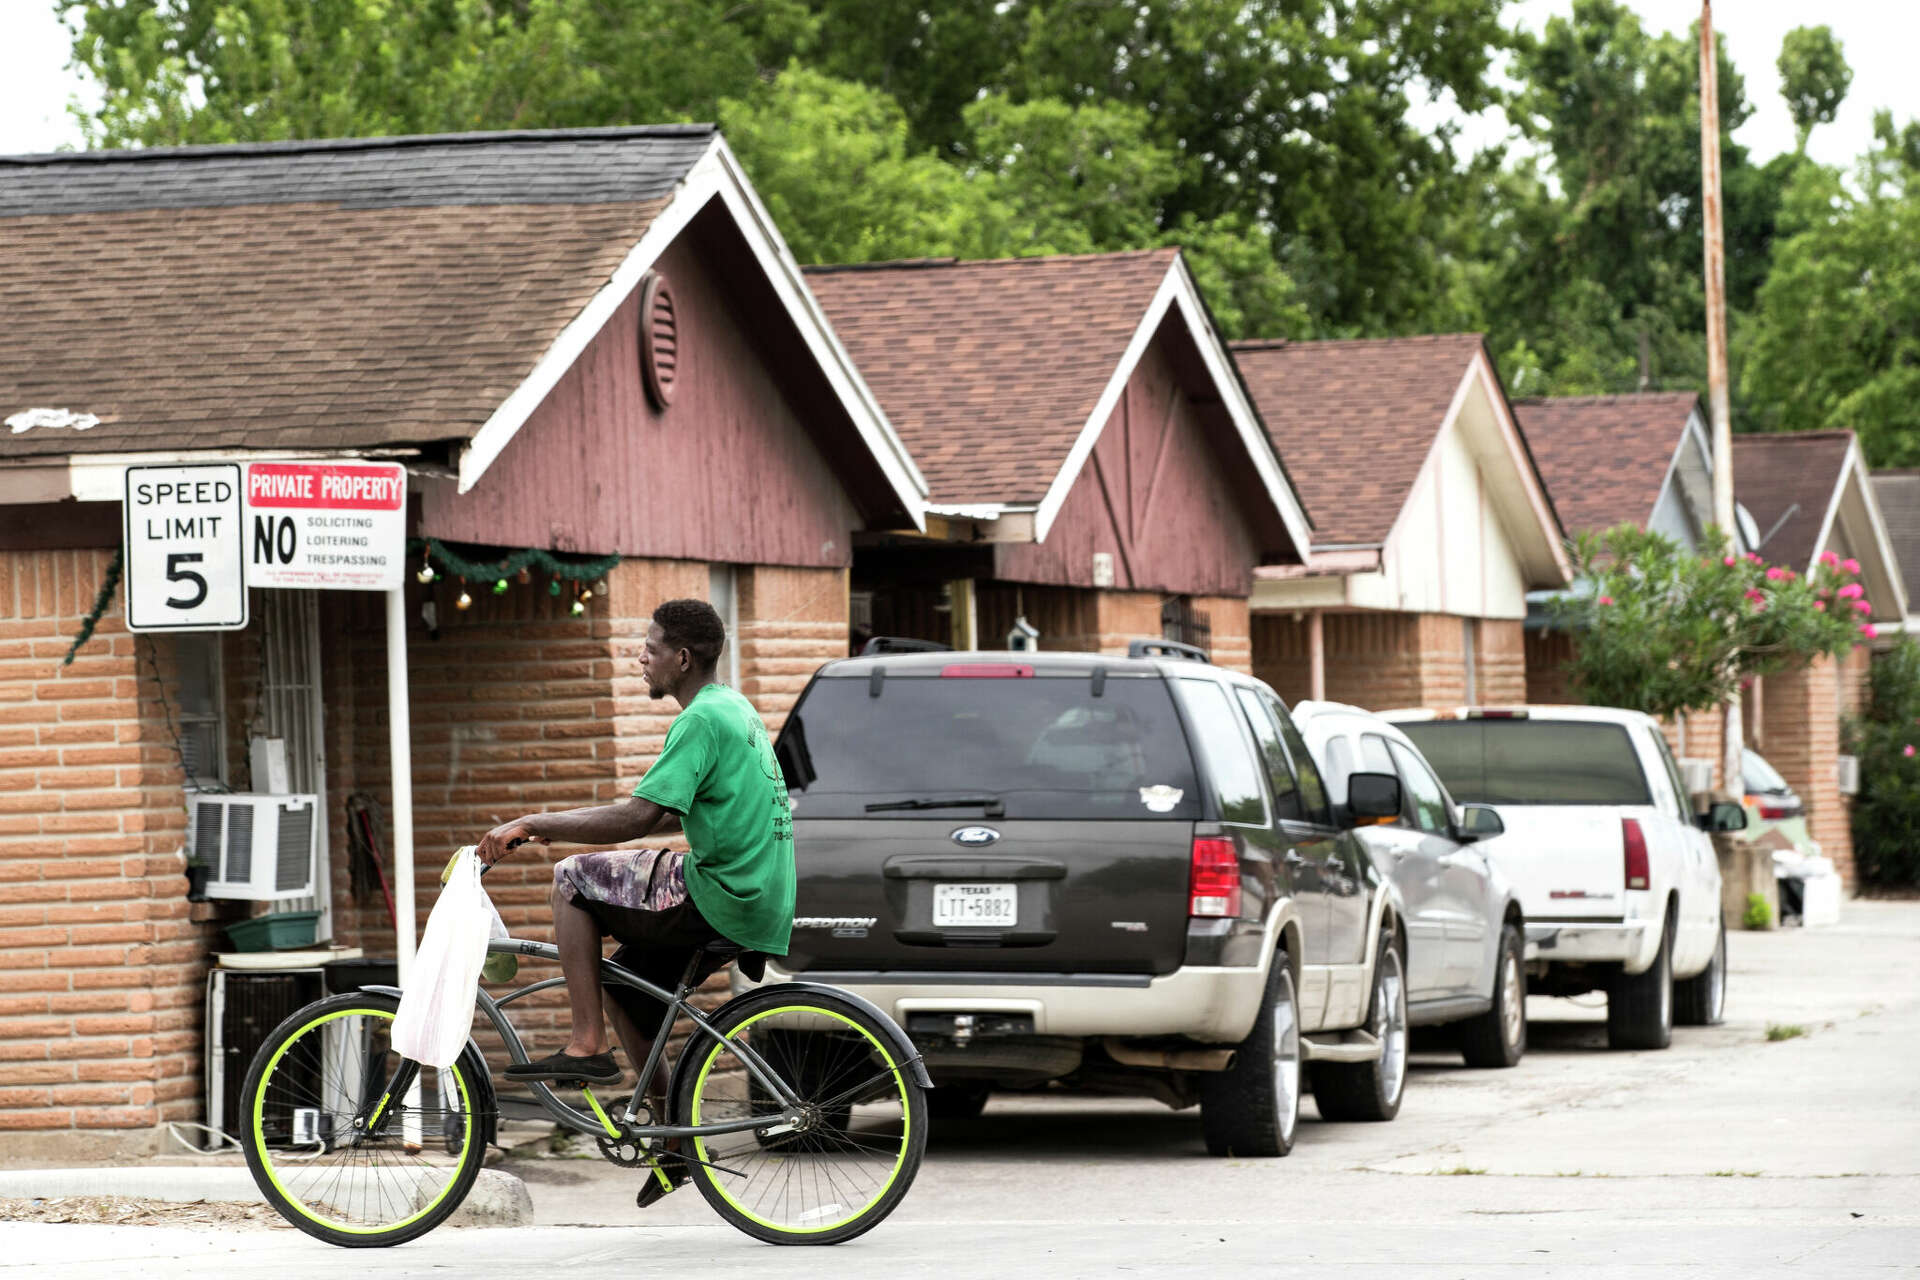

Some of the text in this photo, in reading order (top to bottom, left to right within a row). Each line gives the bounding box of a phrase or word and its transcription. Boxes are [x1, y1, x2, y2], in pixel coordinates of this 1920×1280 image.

[137, 482, 231, 505] SPEED
[251, 474, 400, 500] PRIVATE PROPERTY
[148, 517, 222, 540] LIMIT
[306, 517, 373, 528] SOLICITING
[254, 515, 297, 564] NO
[306, 535, 369, 547] LOITERING
[306, 554, 387, 566] TRESPASSING
[165, 552, 208, 609] 5
[960, 887, 991, 895] TEXAS
[792, 917, 877, 928] XPEDITION
